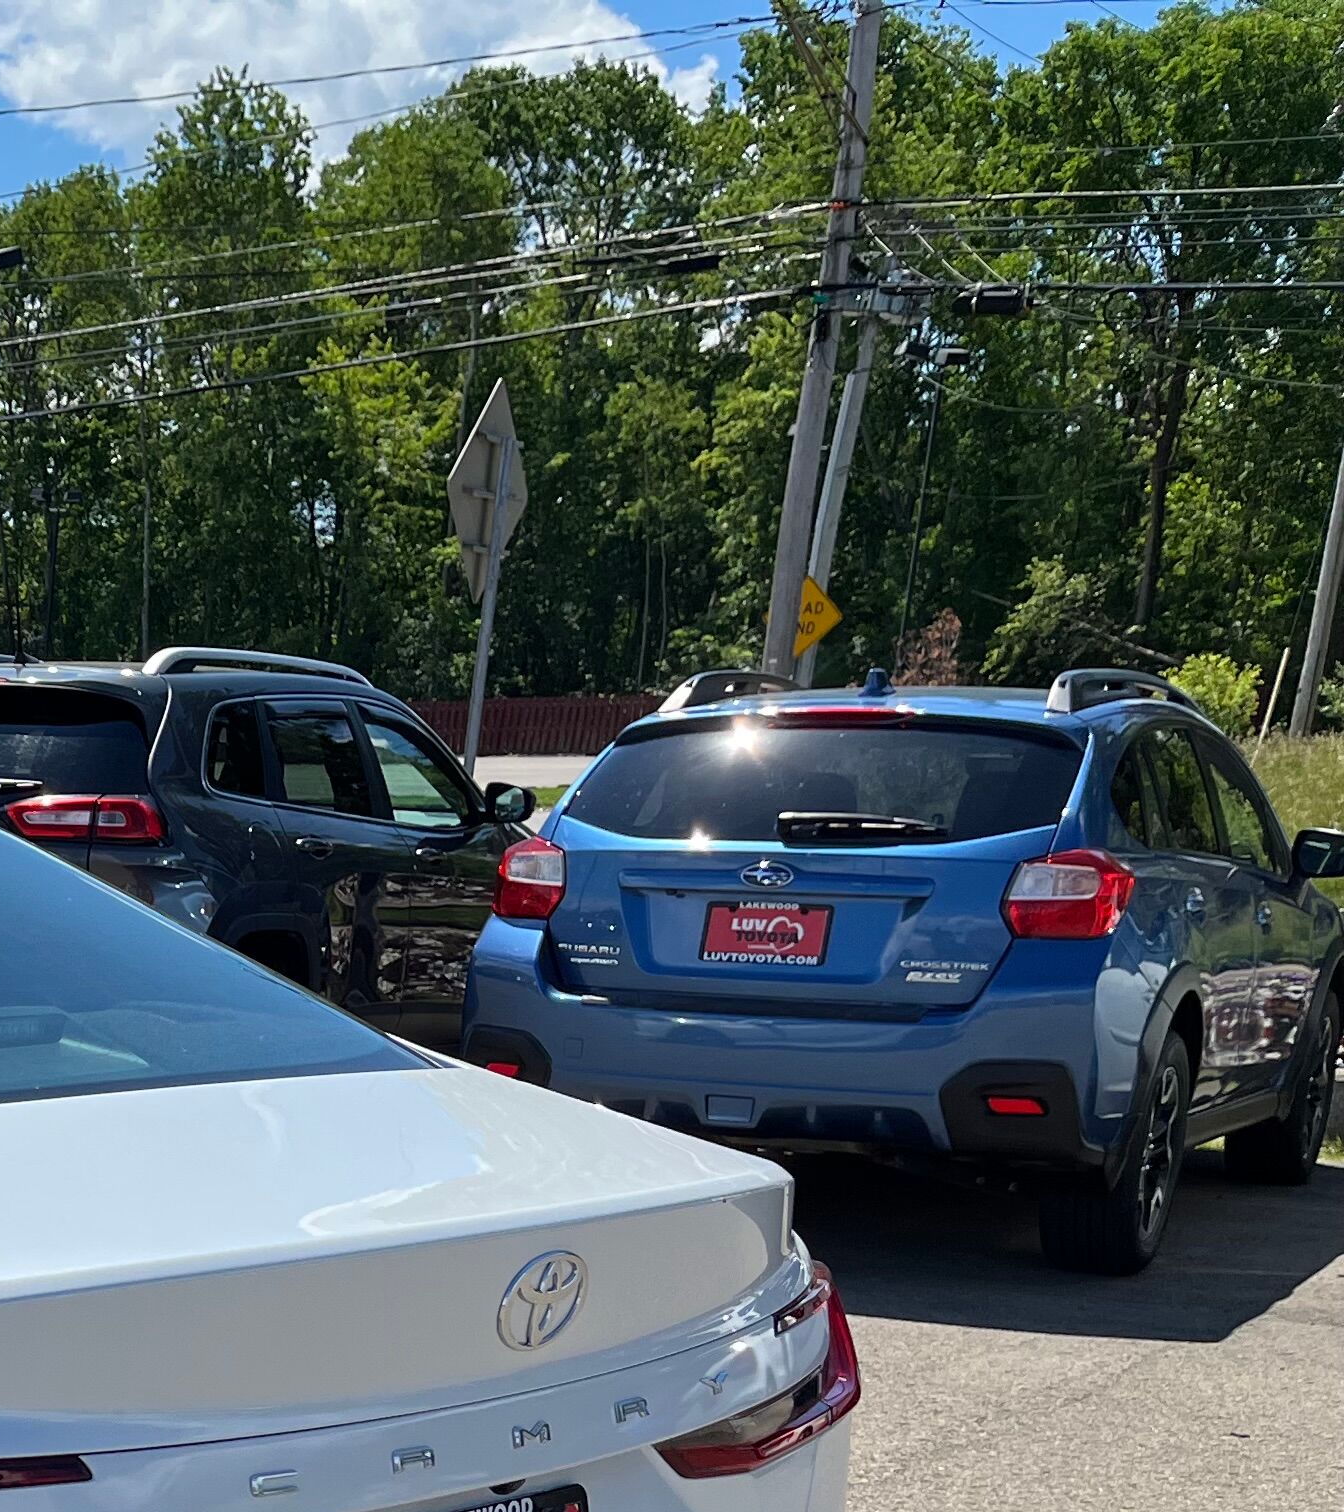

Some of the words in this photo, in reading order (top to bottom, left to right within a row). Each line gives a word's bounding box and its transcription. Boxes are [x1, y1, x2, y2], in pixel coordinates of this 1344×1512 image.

[802, 601, 824, 615] AD
[739, 901, 800, 911] LAKEWOOD
[731, 918, 768, 931] LUV
[736, 930, 800, 944] TOYOTA
[558, 943, 621, 955] SUBARU
[703, 952, 818, 966] LUVTOYOTA.COM
[249, 1370, 728, 1498] CAMRY
